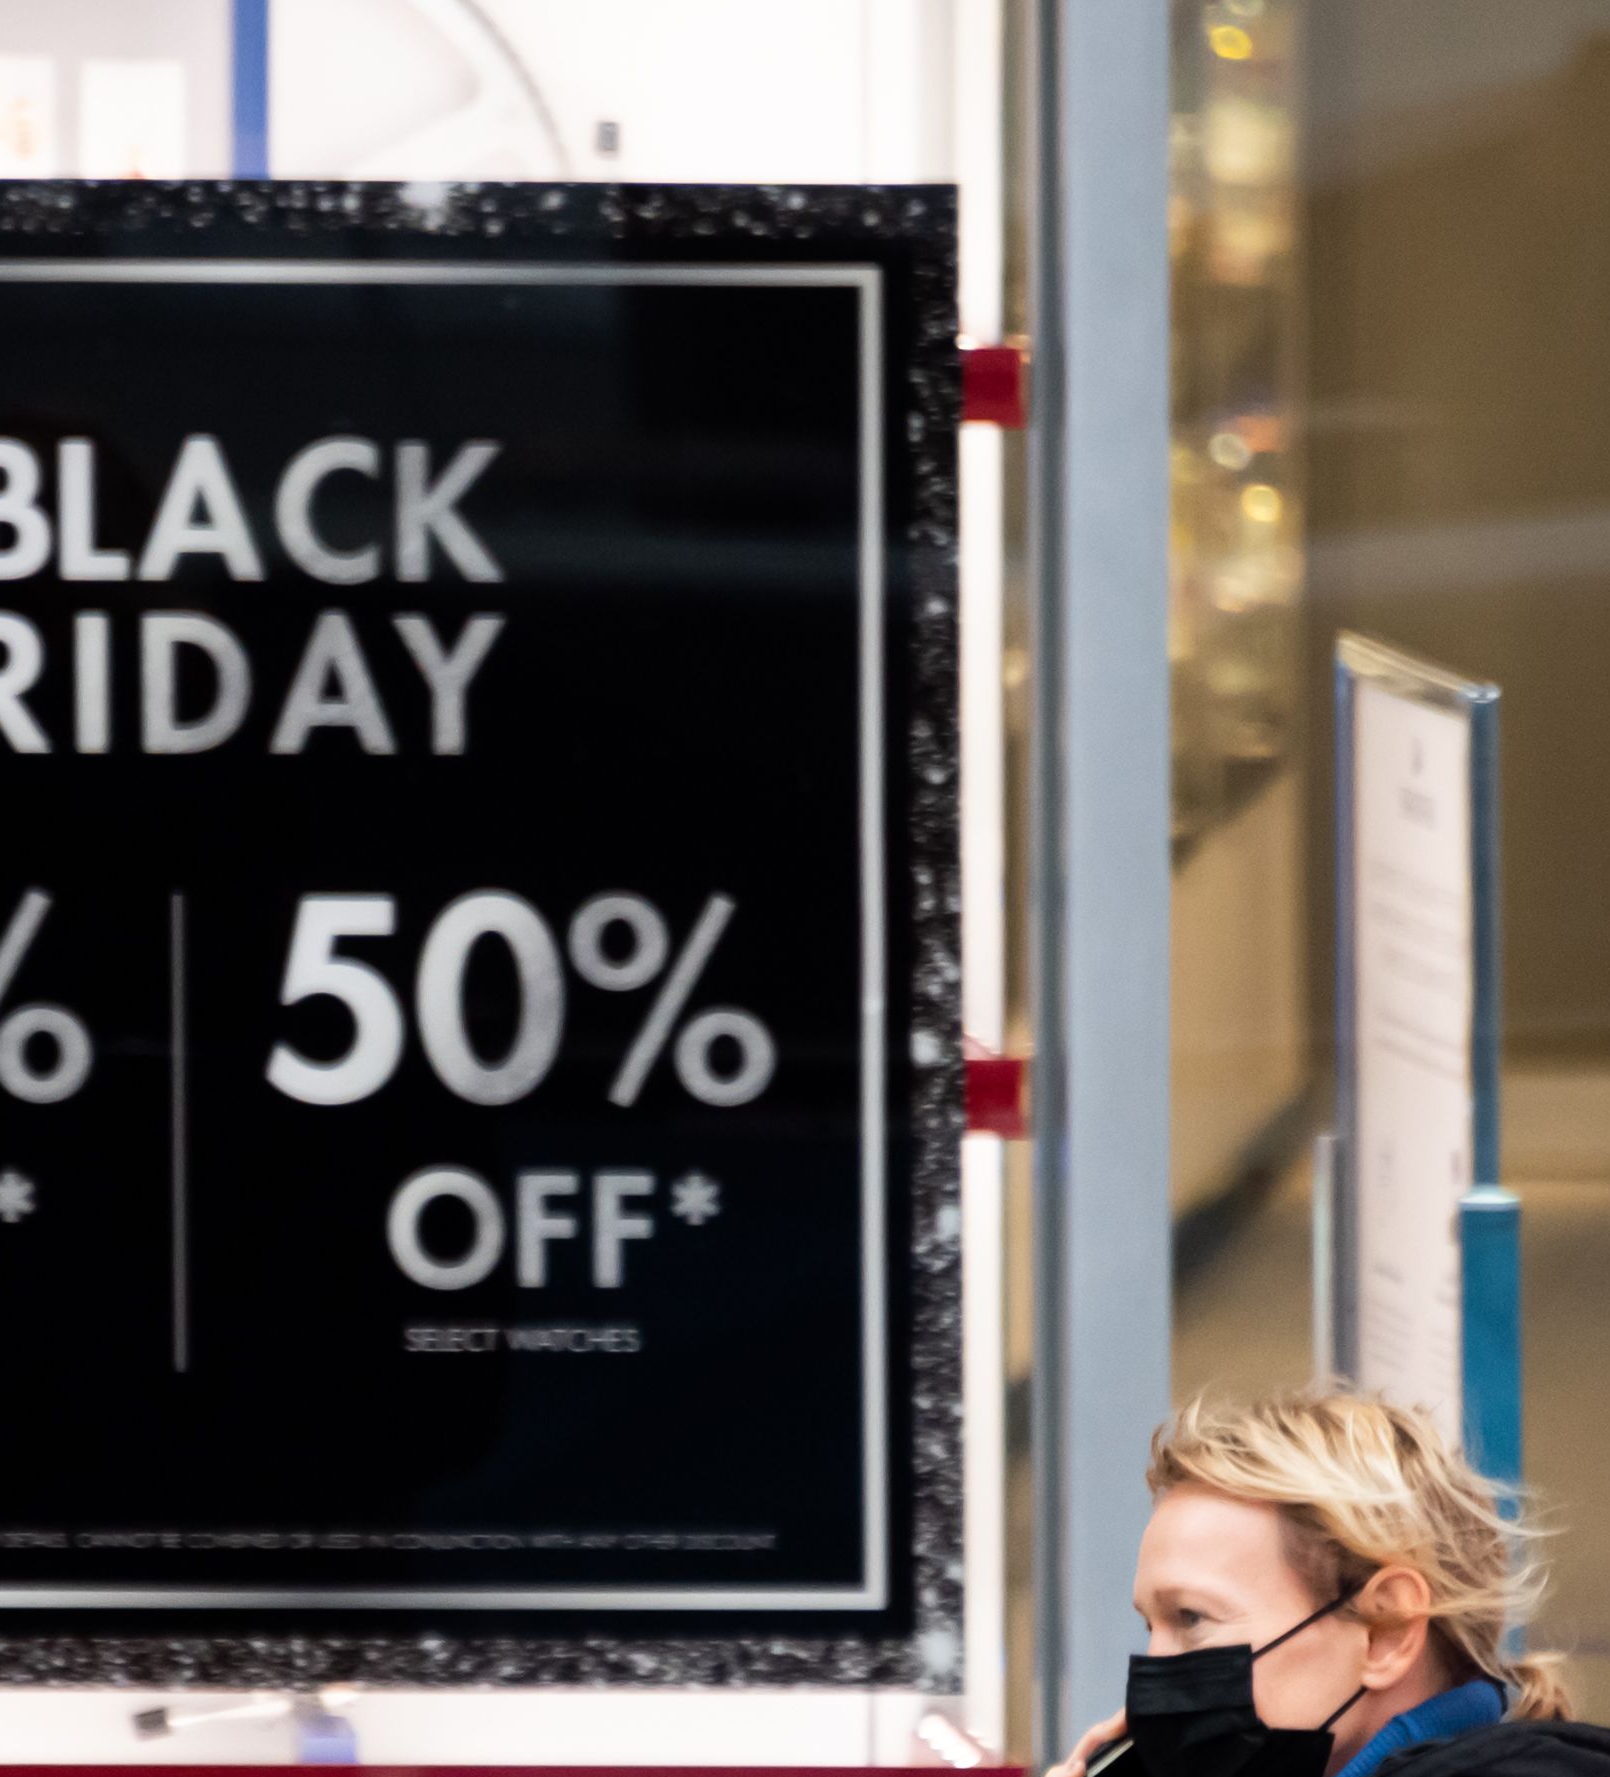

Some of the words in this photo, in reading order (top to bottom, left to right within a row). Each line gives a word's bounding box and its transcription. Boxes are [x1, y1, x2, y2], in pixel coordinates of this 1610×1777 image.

[265, 888, 778, 1107] 50%
[404, 1327, 499, 1352] SELECT
[502, 1327, 642, 1352] WATCHES
